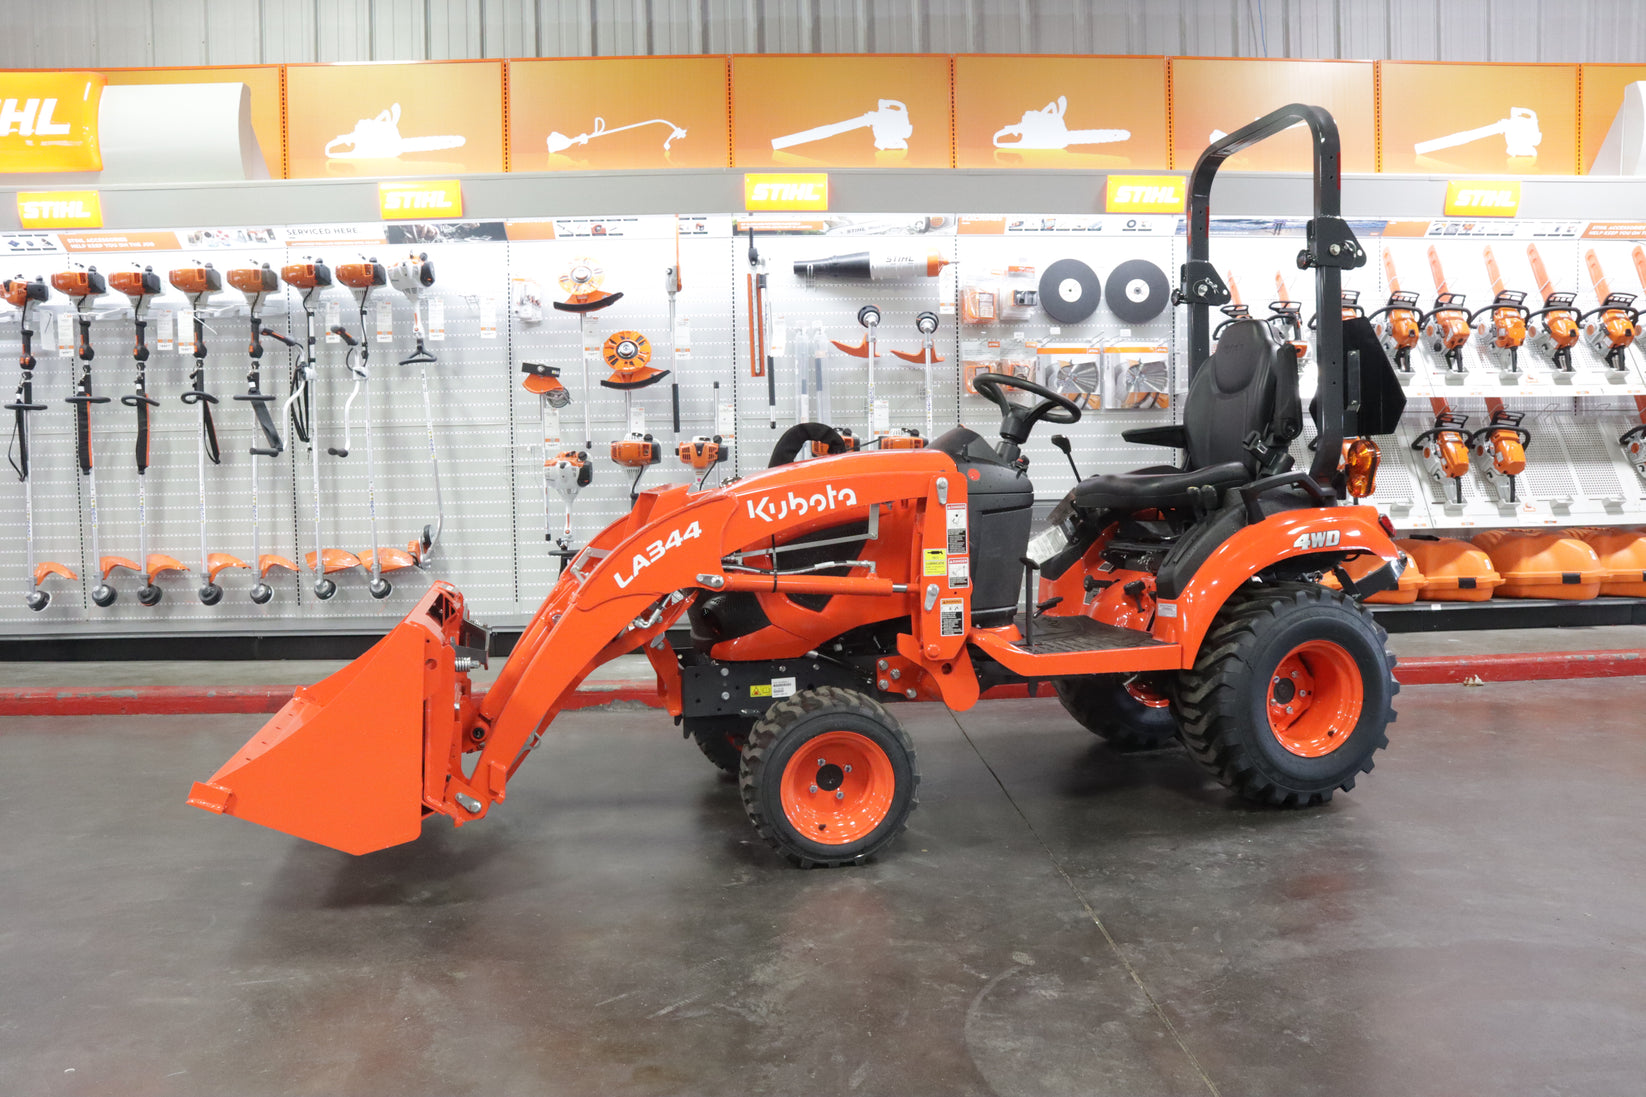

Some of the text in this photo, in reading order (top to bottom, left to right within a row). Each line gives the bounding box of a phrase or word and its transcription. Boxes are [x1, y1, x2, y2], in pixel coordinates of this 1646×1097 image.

[0, 98, 71, 136] HL
[384, 189, 452, 209] STIHL
[751, 183, 822, 201] STIHL
[1113, 185, 1180, 203] STIHL
[1453, 189, 1516, 207] STIHL
[21, 200, 91, 219] STIHL
[286, 227, 331, 235] SERVICED
[747, 484, 857, 522] Kubota
[1292, 529, 1341, 551] 4WD
[613, 520, 702, 589] LA344
